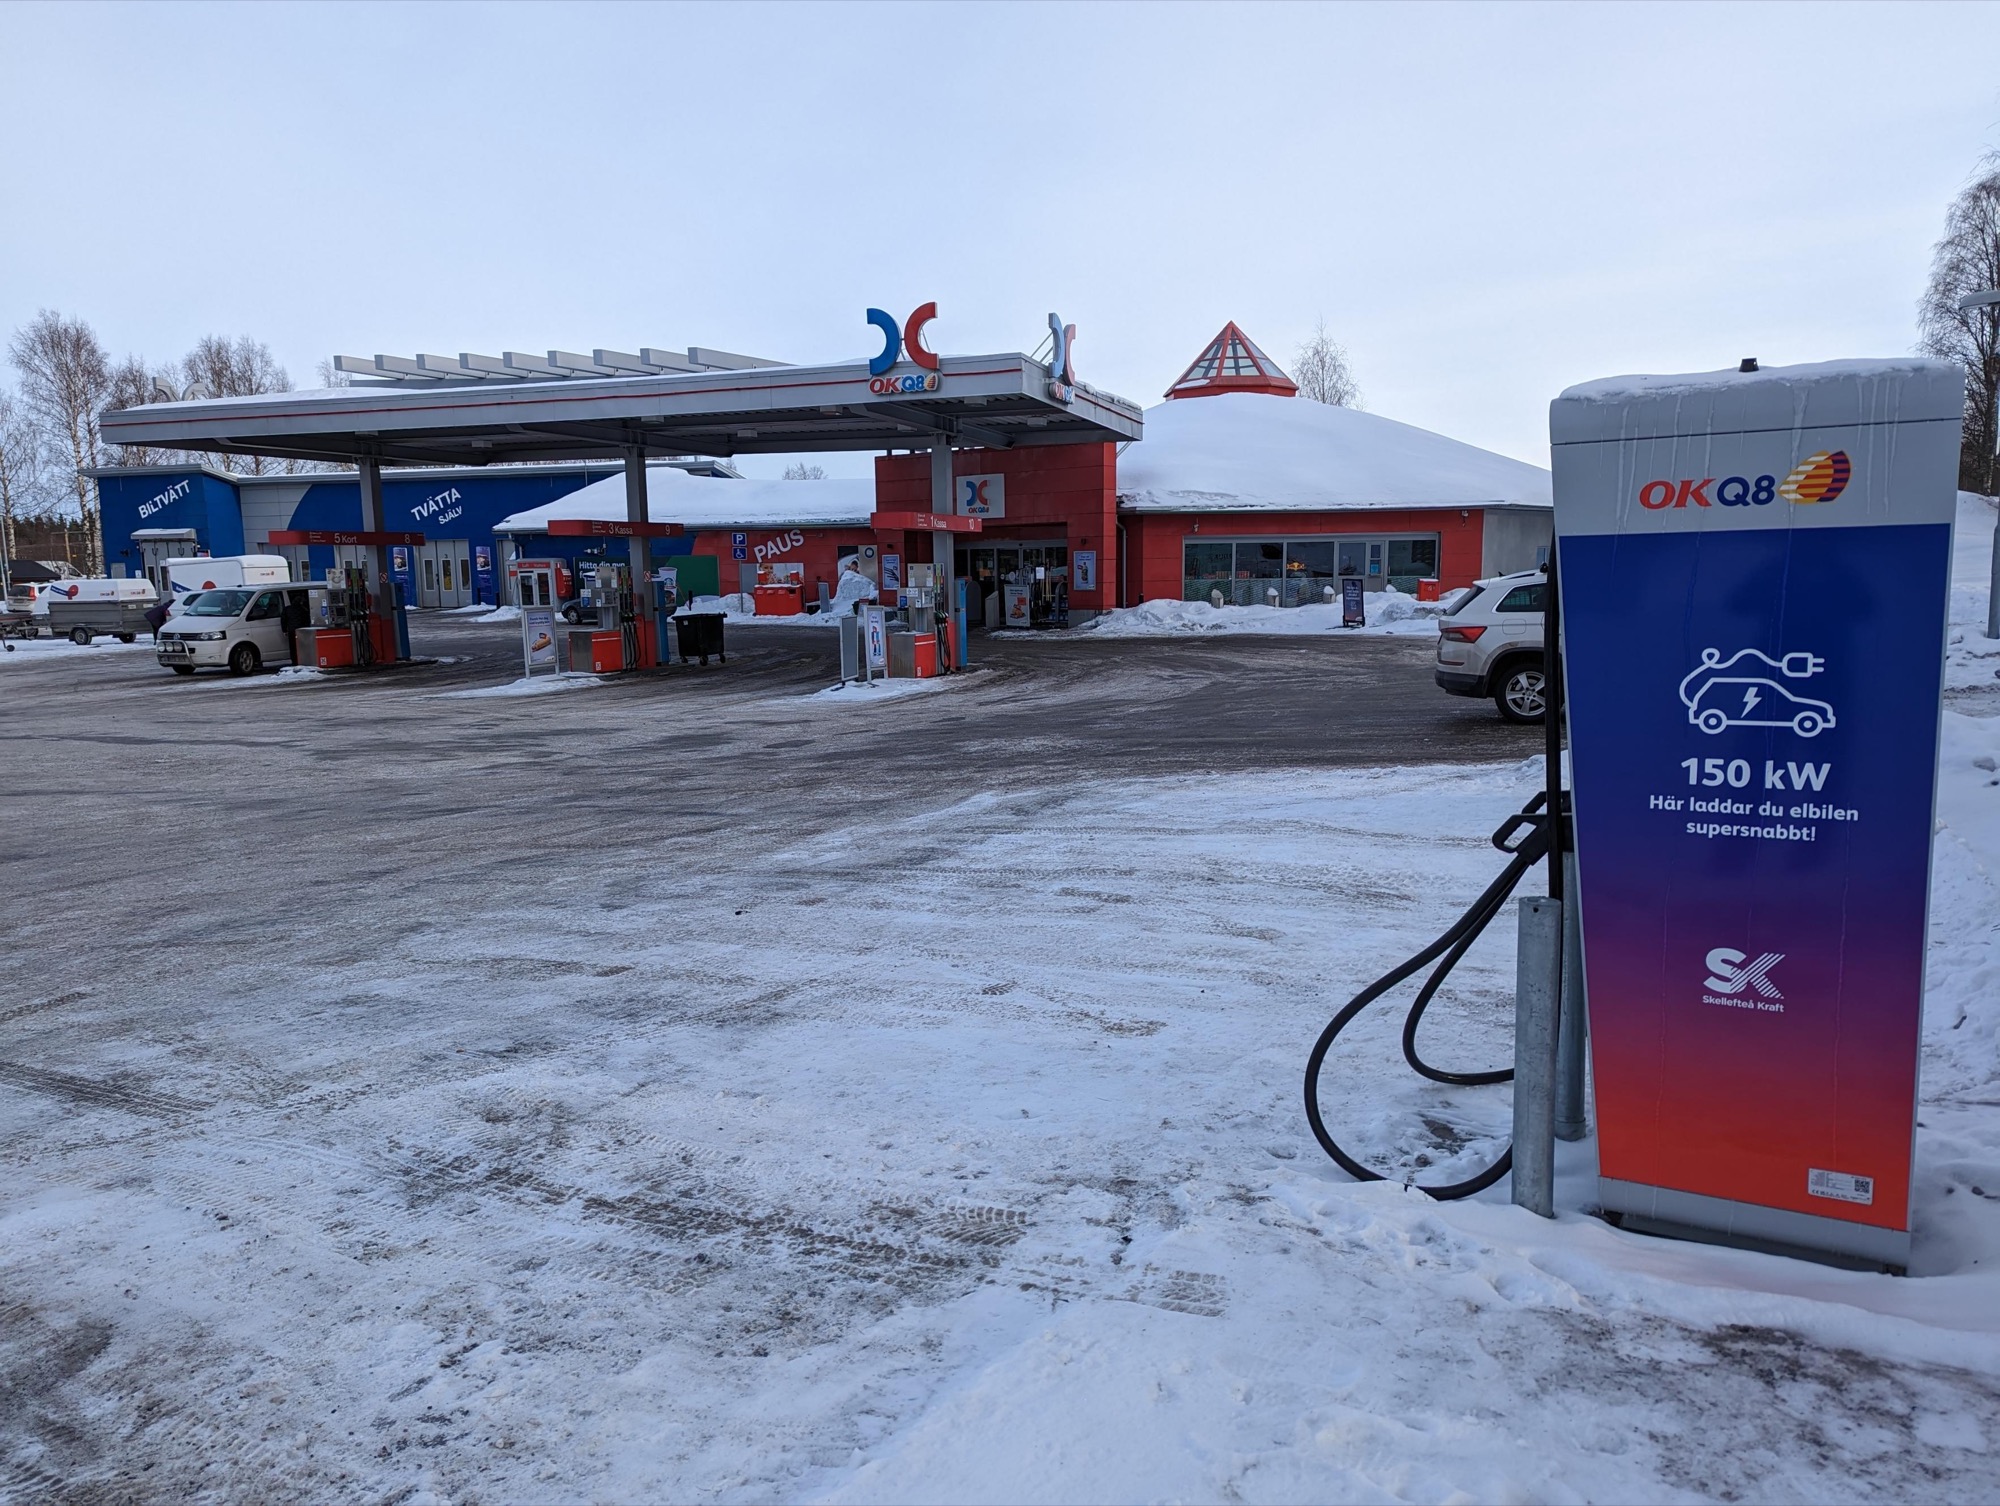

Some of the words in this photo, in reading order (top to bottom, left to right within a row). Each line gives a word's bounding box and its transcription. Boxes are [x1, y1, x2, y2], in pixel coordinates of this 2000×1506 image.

[138, 479, 190, 519] BILTVÄTT
[1639, 475, 1776, 510] OKQ8
[410, 488, 462, 521] TVÄTTA
[438, 505, 462, 524] SJÄLV
[934, 518, 947, 528] Kassa
[968, 518, 975, 530] 10
[334, 532, 340, 543] 5
[341, 534, 357, 543] Kort
[404, 533, 411, 543] 8
[608, 523, 614, 534] 3
[615, 526, 633, 535] Kassa
[665, 524, 671, 535] 9
[736, 534, 743, 544] P
[753, 529, 804, 563] PAUS
[1681, 757, 1751, 788] 150
[1764, 760, 1832, 791] kW
[1649, 795, 1685, 811] Här
[1689, 797, 1754, 815] laddar
[1758, 801, 1784, 817] du
[1789, 803, 1859, 821] elbilen
[1686, 821, 1816, 842] supersnabbt!
[1703, 947, 1786, 999] SK
[1703, 996, 1755, 1009] Skellefteå
[1757, 1000, 1785, 1013] Kraft
